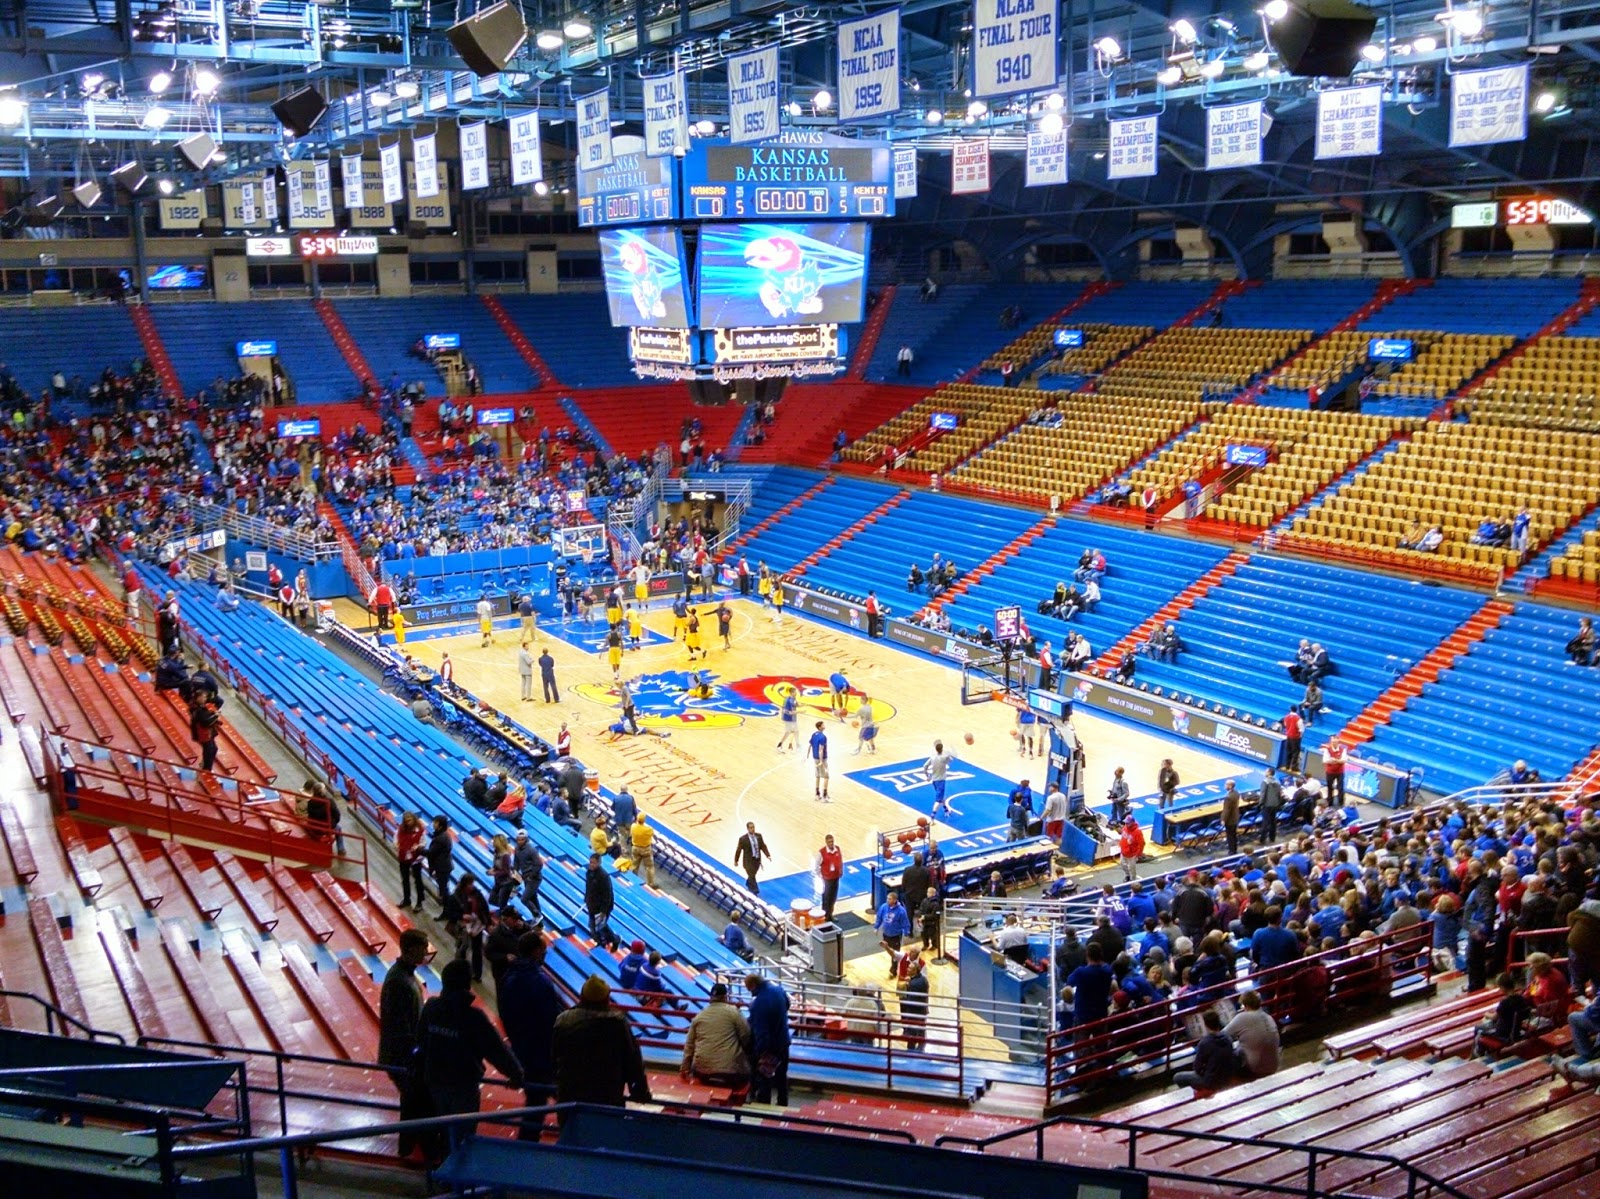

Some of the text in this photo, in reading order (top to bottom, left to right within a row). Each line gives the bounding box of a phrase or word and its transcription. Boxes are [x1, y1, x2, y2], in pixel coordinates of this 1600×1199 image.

[854, 24, 884, 52] NCAA
[979, 13, 1051, 48] FINAL FOUR
[741, 59, 765, 83] NCAA
[841, 56, 869, 77] FINAL
[996, 53, 1031, 84] 1940
[654, 82, 675, 103] NCAA
[731, 80, 777, 105] FINAL FOUR
[854, 83, 882, 109] 1952
[1340, 92, 1361, 105] MVC
[1457, 86, 1522, 106] CHAMPIONS
[743, 110, 765, 133] 1953
[1220, 107, 1250, 122] BIG SIX
[1322, 105, 1377, 122] CHAMPIONS
[1121, 121, 1147, 135] BIG SIX
[1211, 119, 1258, 136] CHAMPIONS
[1112, 133, 1153, 147] CHAMPIONS
[752, 148, 830, 165] KANSAS
[957, 143, 985, 156] BIG EIGHT
[1029, 145, 1065, 157] CHAMPIONS
[955, 153, 987, 166] CHAMPIONS
[597, 171, 649, 191] BASKETBALL
[735, 166, 848, 182] BASKETBALL
[691, 186, 726, 195] KANSAS
[854, 186, 876, 195] KENT
[877, 186, 888, 195] ST
[760, 191, 806, 210] 60:00
[814, 197, 822, 212] 0
[169, 207, 199, 219] 1922
[360, 206, 386, 219] 1988
[415, 206, 445, 218] 2008
[1507, 199, 1552, 224] 5:39
[300, 238, 336, 256] 5:39
[225, 272, 238, 281] 22
[539, 264, 547, 275] 2
[736, 332, 819, 347] theParkingSpot
[713, 361, 838, 385] Russell Stover Candies
[996, 609, 1018, 621] 60:00
[999, 619, 1017, 636] 35
[608, 769, 722, 828] KANSAS
[1111, 900, 1125, 912] 16
